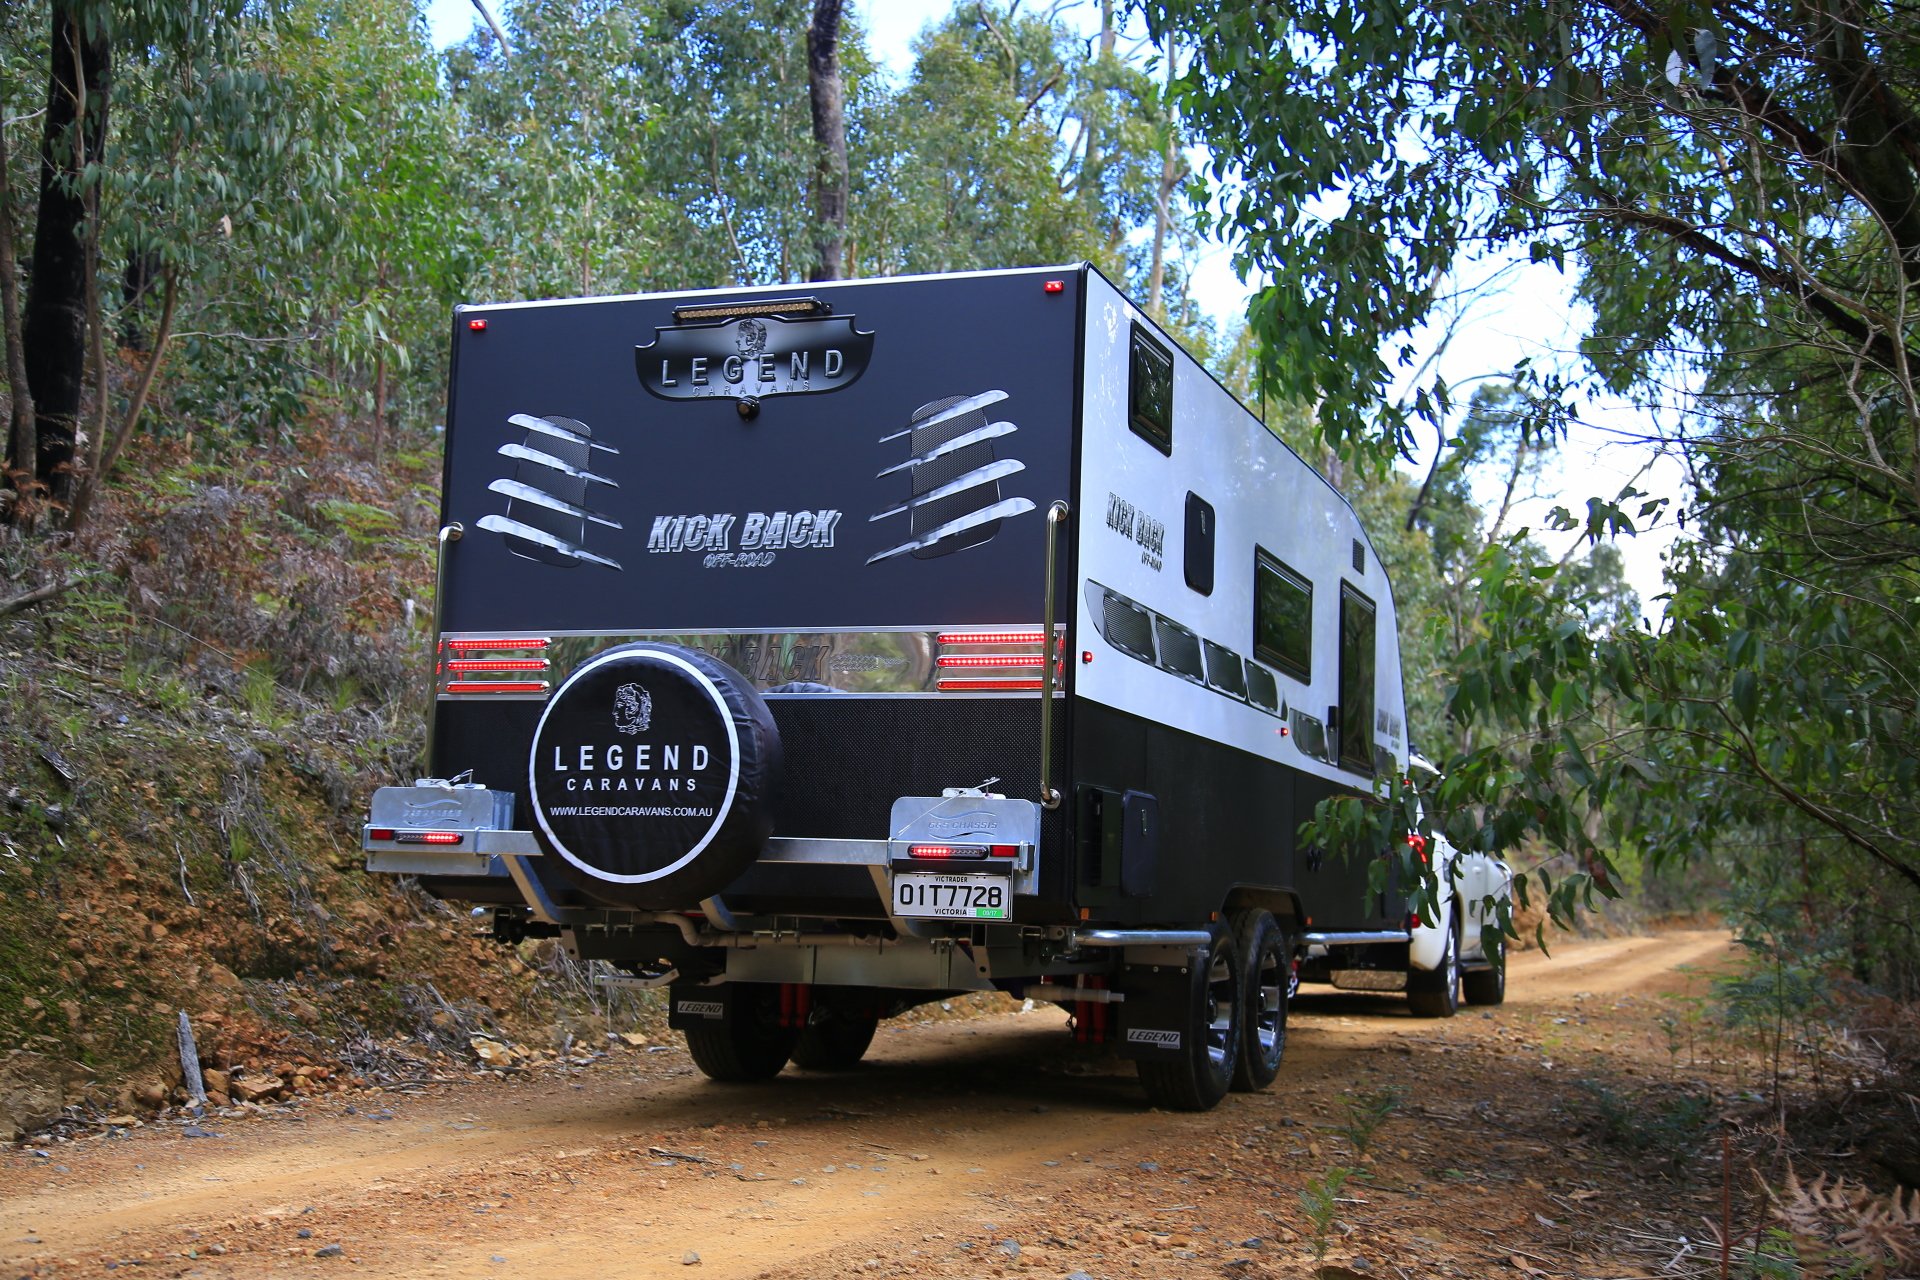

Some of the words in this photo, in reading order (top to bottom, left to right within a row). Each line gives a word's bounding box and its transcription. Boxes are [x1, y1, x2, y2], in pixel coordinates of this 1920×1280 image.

[661, 349, 844, 386] LEGEND
[692, 380, 811, 398] CARAVANS
[647, 513, 736, 553] KICK
[740, 509, 843, 550] BACK
[1106, 491, 1134, 541] KICK
[1136, 510, 1164, 558] BACK
[702, 551, 776, 568] OFF-ROAD
[742, 645, 830, 681] BACK
[554, 744, 709, 771] LEGEND
[566, 778, 697, 792] CARAVANS
[550, 806, 713, 817] WWW.LEGENDCARAVANS.COM.AU
[952, 821, 999, 829] CHASSIS
[900, 884, 1002, 908] 01T7728
[934, 908, 967, 916] VICTORIA
[679, 1003, 722, 1013] LEGEND
[1129, 1031, 1179, 1042] LEGEND
